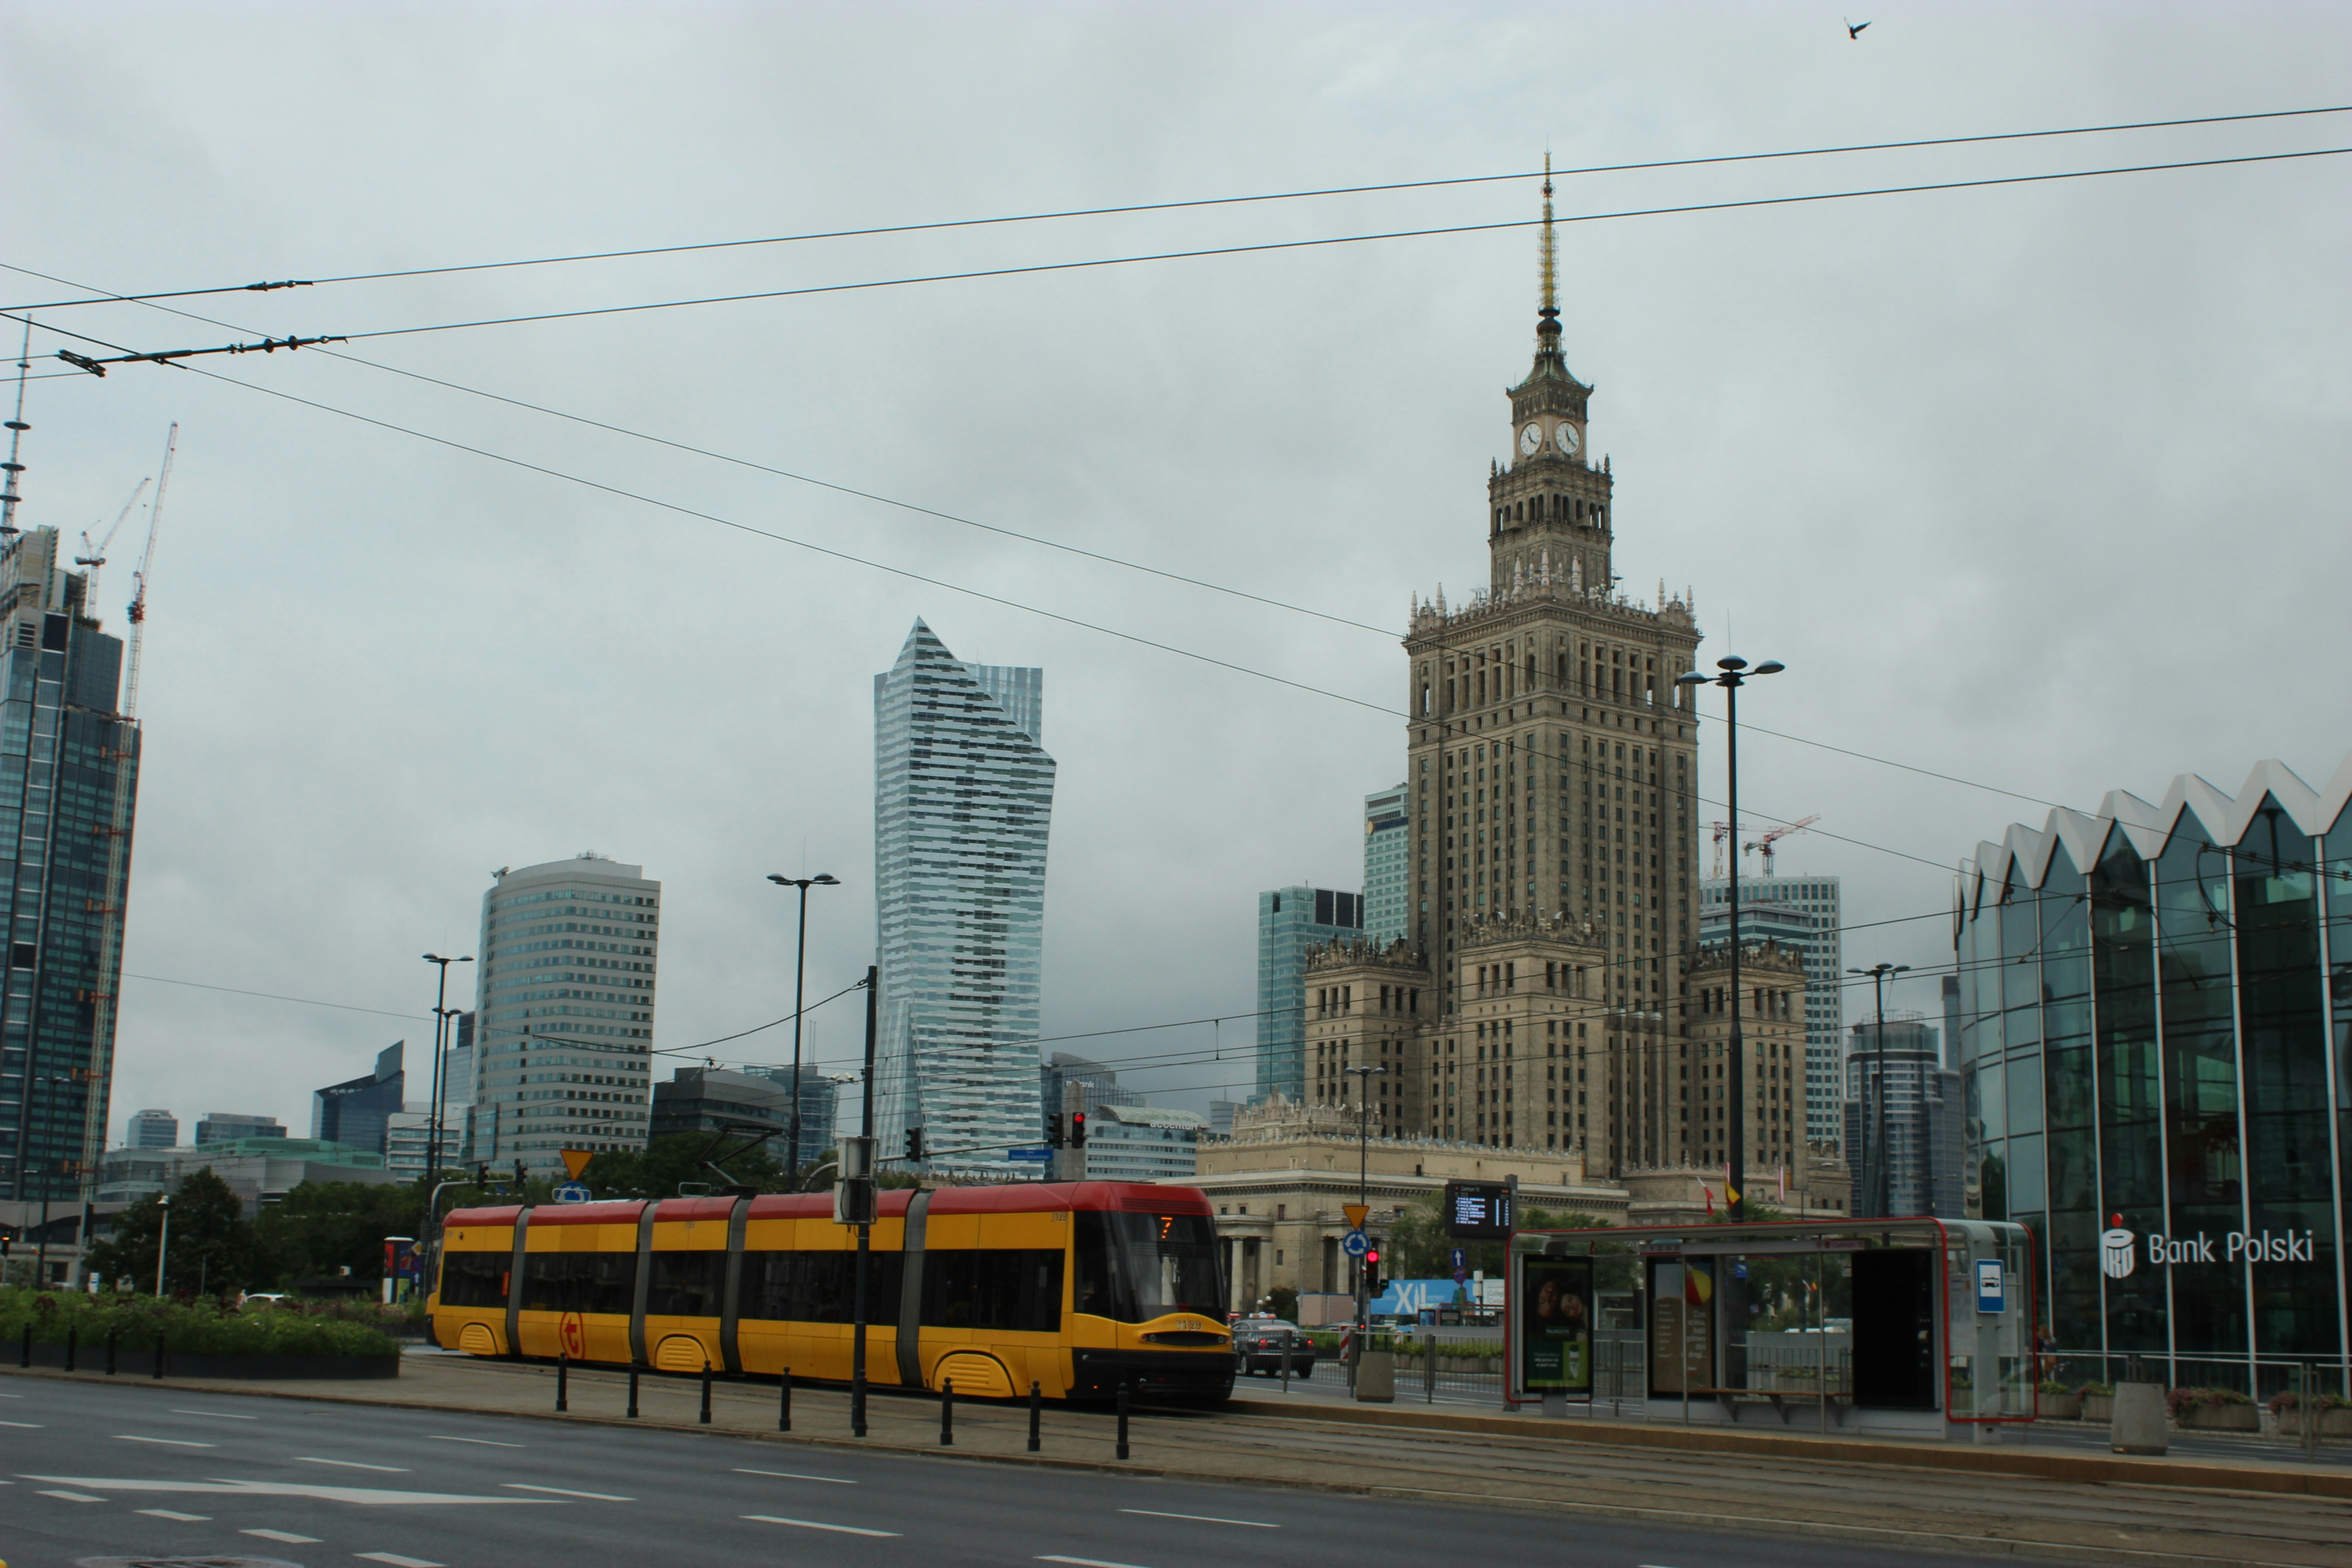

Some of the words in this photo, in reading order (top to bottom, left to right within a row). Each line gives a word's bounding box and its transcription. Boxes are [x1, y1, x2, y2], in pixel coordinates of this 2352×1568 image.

[1052, 1212, 1067, 1222] 3129
[1161, 1217, 1173, 1239] 7
[2149, 1231, 2216, 1264] Bank
[2227, 1229, 2313, 1262] Polski
[1176, 1320, 1201, 1331] 3129
